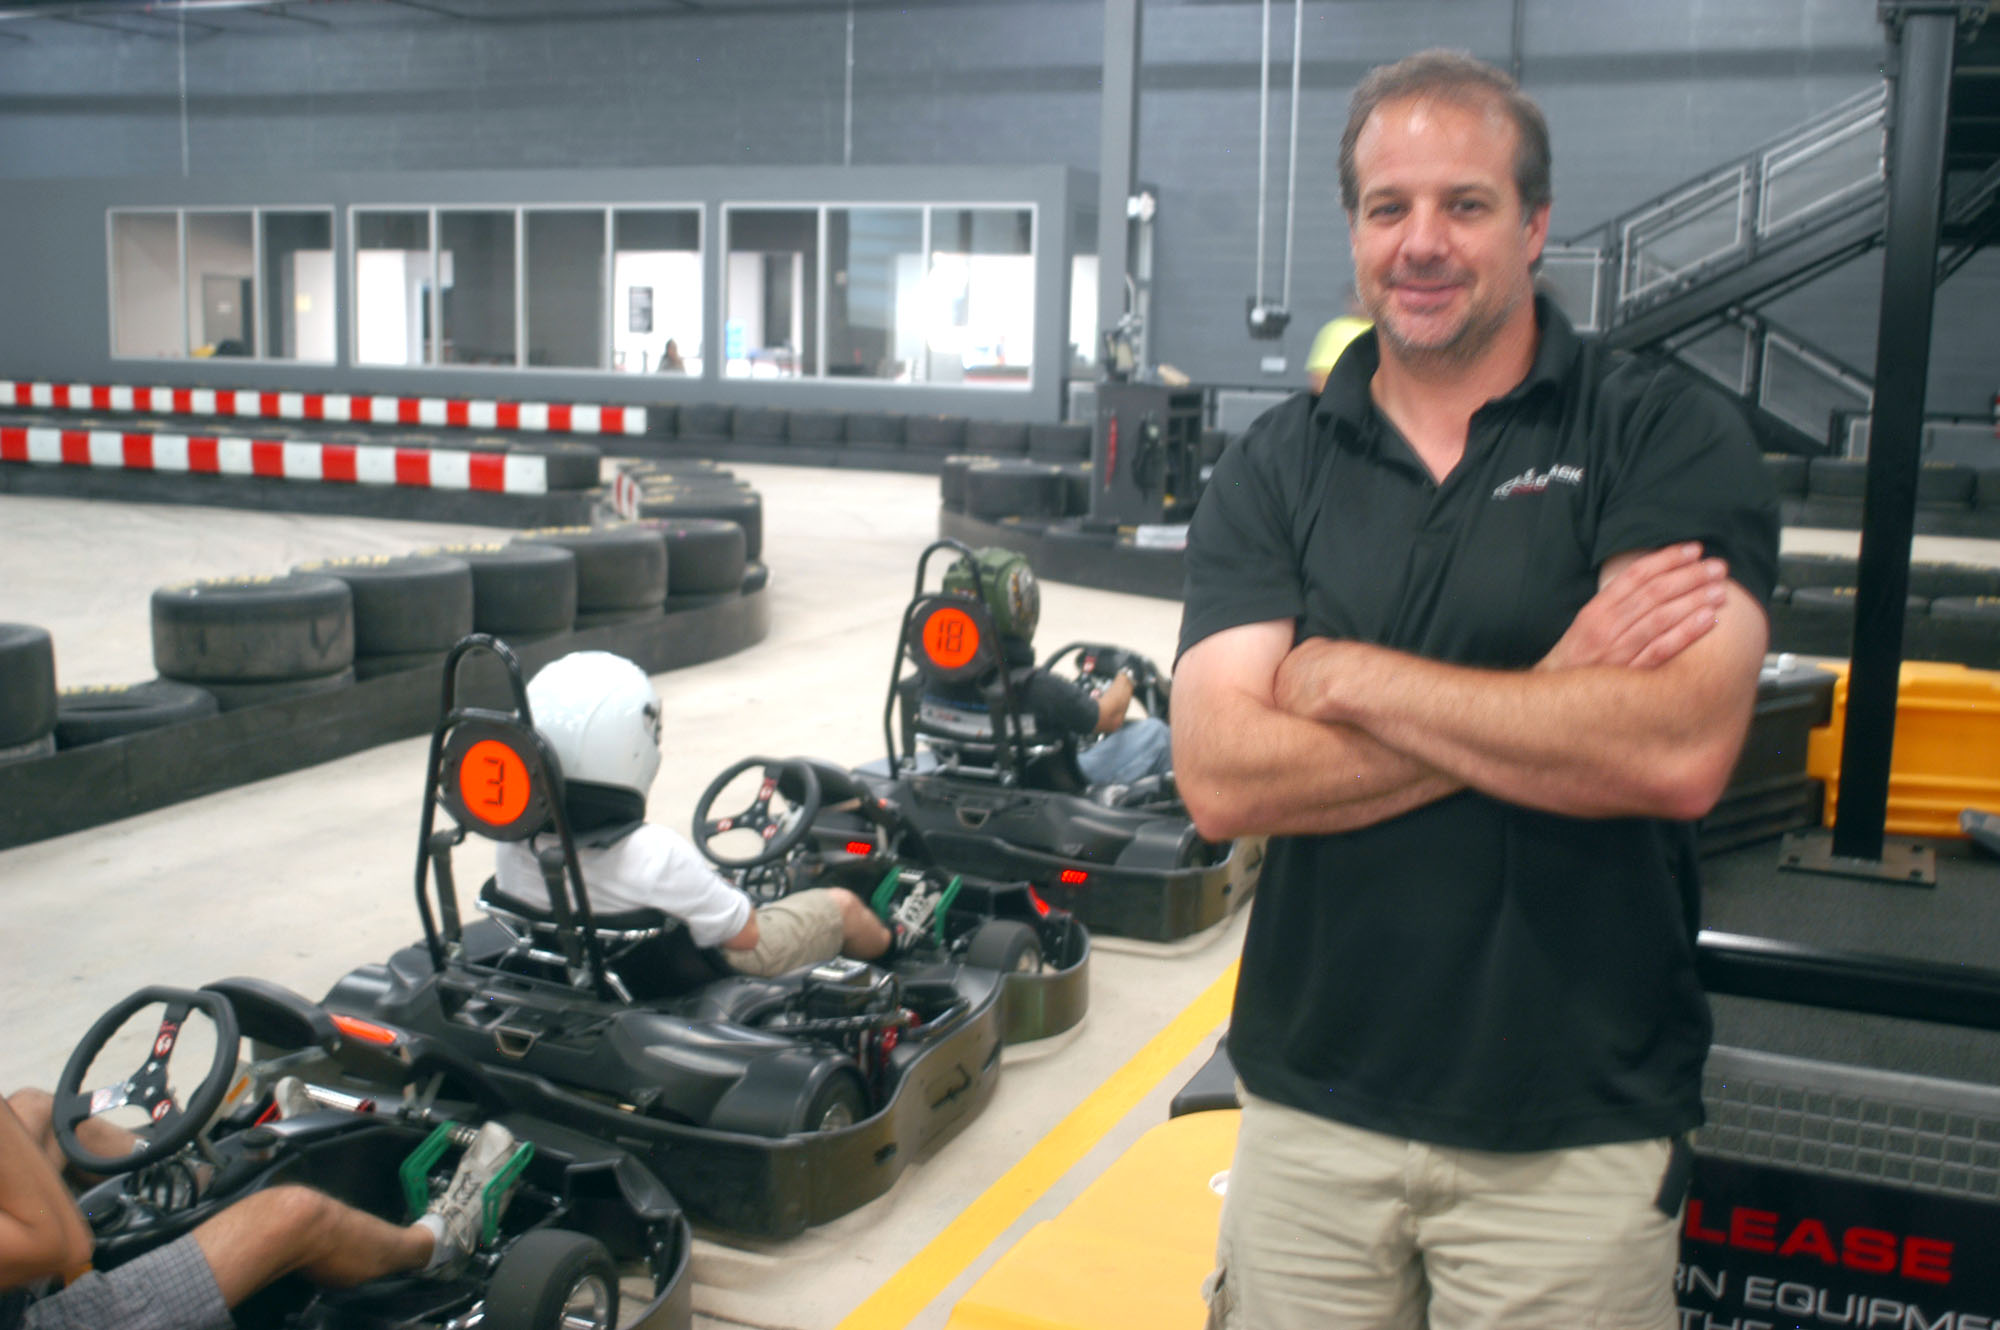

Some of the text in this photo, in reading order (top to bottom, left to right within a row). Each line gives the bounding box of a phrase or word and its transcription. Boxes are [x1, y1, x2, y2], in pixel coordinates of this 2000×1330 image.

[936, 619, 964, 653] 18
[483, 756, 505, 807] 3
[1684, 1198, 1954, 1284] LEASE
[1744, 1275, 2000, 1330] EQUIPME
